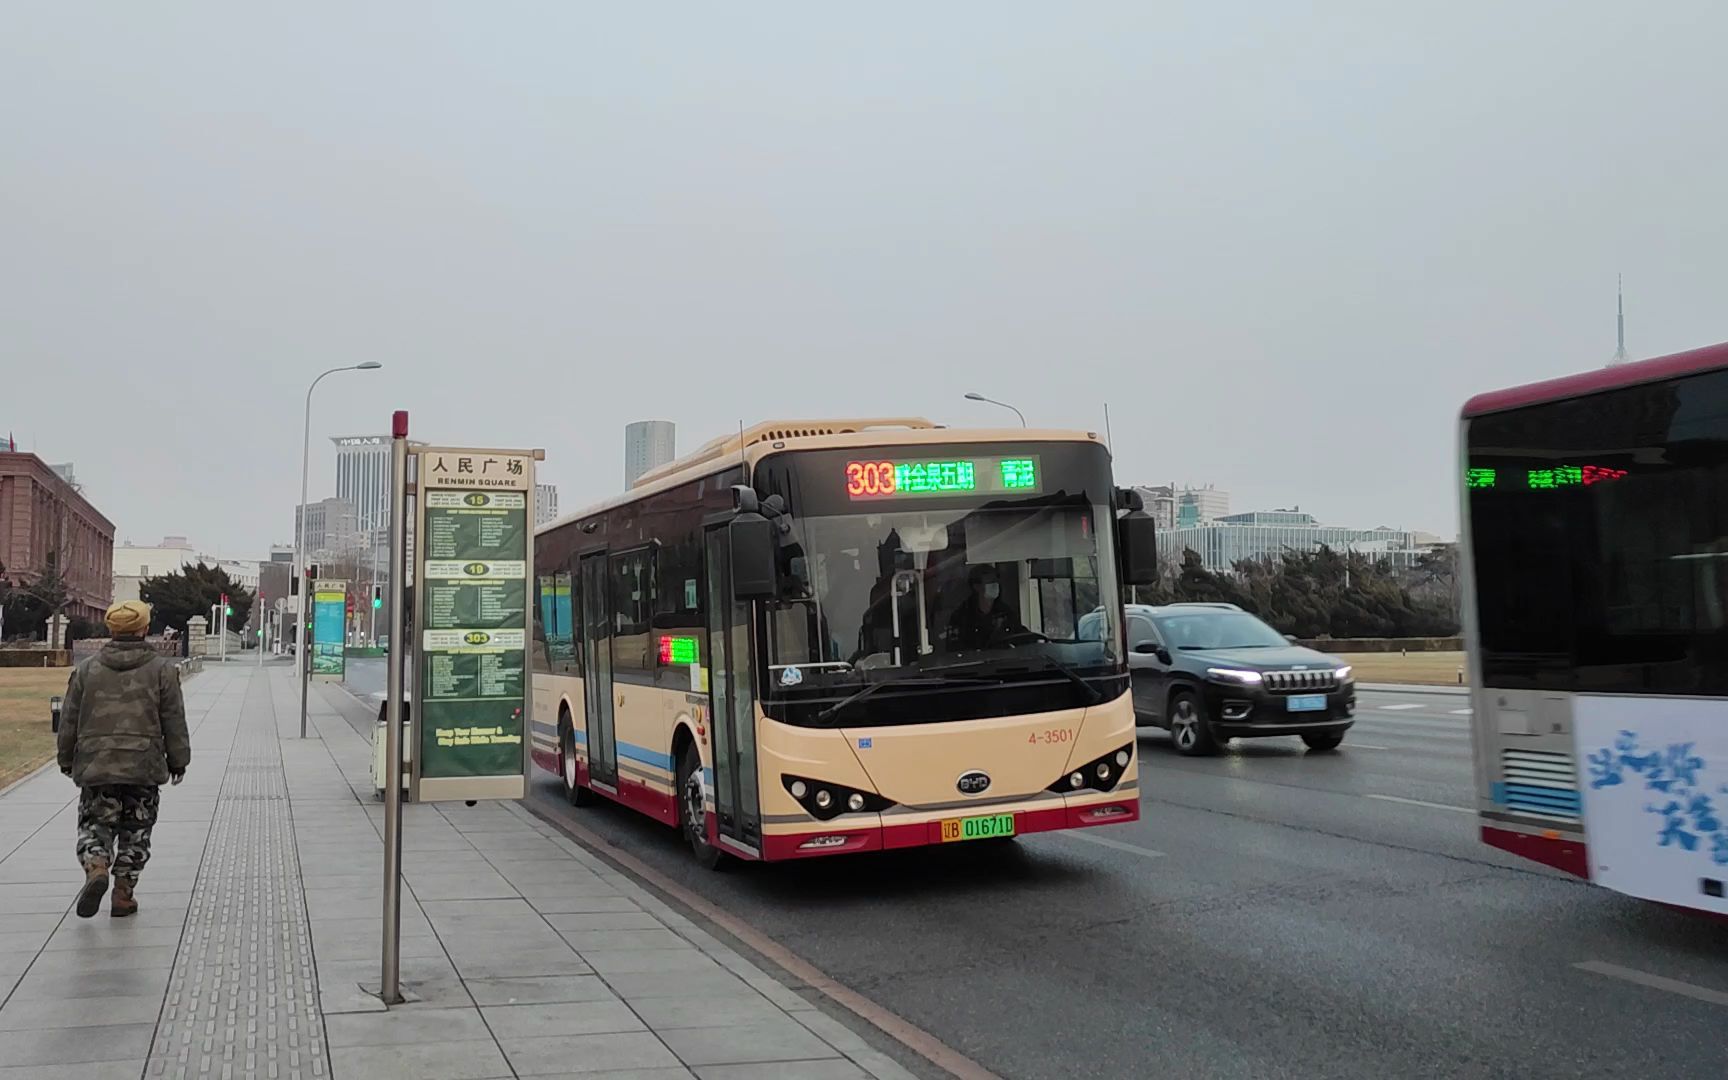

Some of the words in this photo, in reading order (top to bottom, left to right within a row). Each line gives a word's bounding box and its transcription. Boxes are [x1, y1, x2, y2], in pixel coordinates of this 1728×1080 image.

[433, 457, 522, 475] 人民广场
[438, 477, 476, 486] RENMIN
[478, 478, 517, 487] SQUARE
[847, 462, 895, 495] 303
[466, 633, 488, 643] 303
[1029, 729, 1073, 744] 4-3501
[960, 776, 988, 790] BYD
[965, 816, 1013, 837] 01671D
